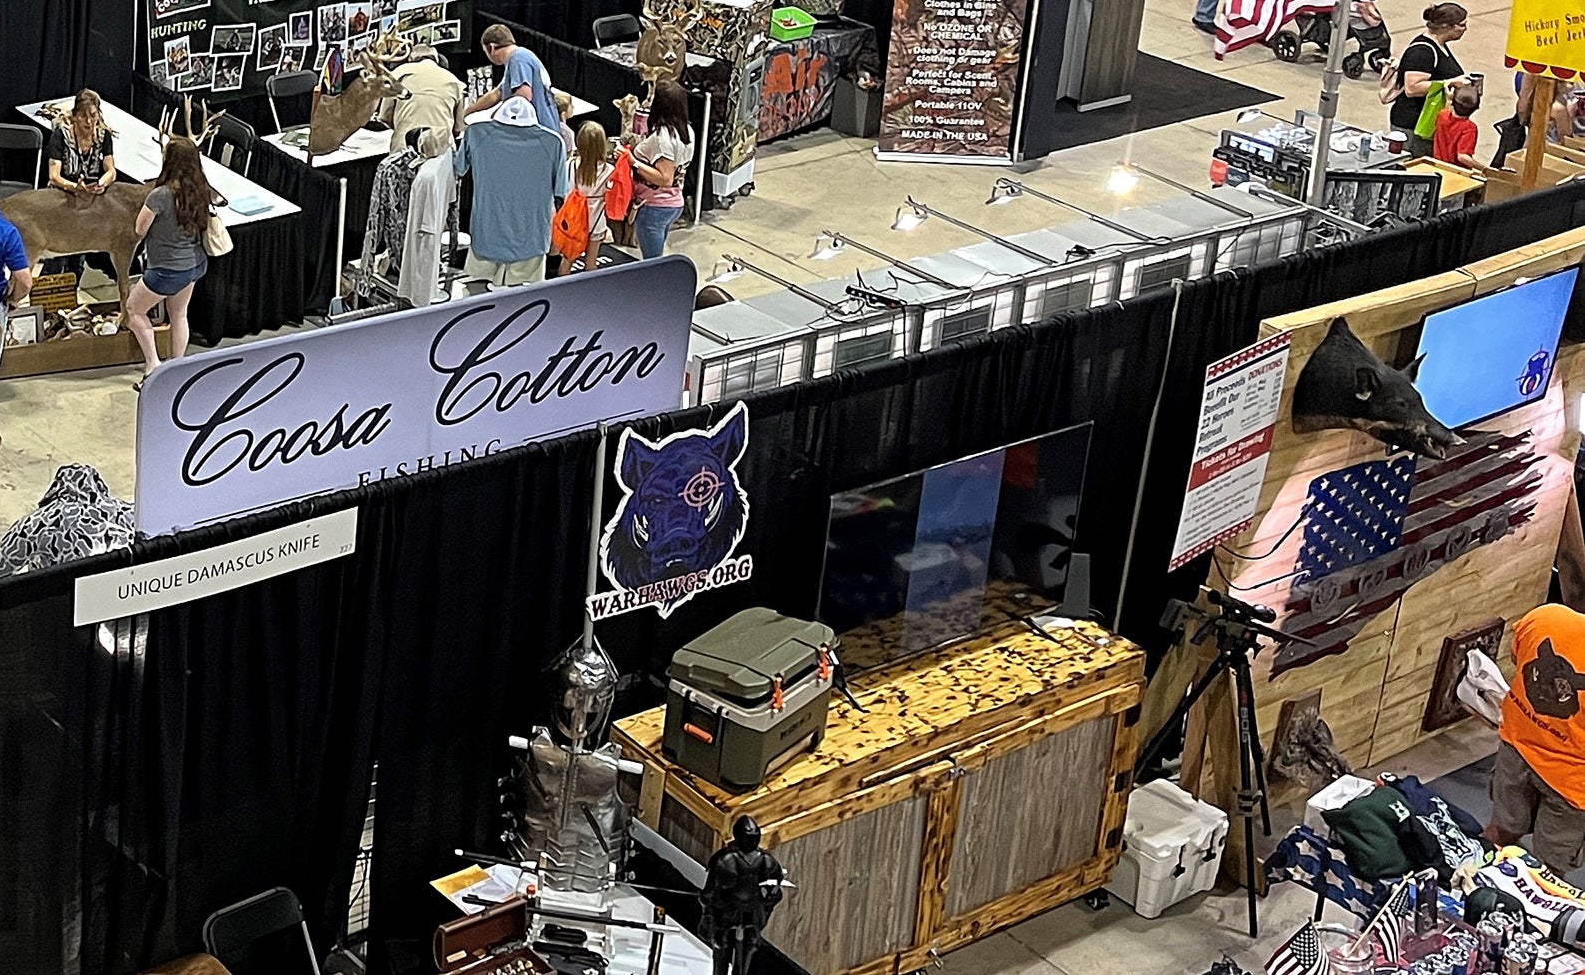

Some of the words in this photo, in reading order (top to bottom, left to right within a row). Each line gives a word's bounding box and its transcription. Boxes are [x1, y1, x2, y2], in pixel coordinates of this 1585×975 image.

[936, 9, 955, 17] and
[151, 19, 207, 39] HUNTING
[939, 24, 975, 33] OZONE
[977, 25, 993, 33] OR
[1525, 18, 1560, 33] Hickory
[930, 32, 983, 41] CHEMICAL
[1536, 32, 1559, 47] Beef
[979, 79, 997, 88] and
[929, 86, 972, 96] Campers
[915, 99, 954, 110] Portable
[909, 115, 933, 125] 100%
[901, 129, 932, 139] MADE
[945, 131, 965, 141] THE
[967, 132, 989, 141] USA
[170, 352, 393, 487] Coosa
[429, 298, 665, 427] Cotton
[118, 573, 183, 600] UNIQUE
[187, 548, 275, 585] DAMASCUS
[278, 533, 321, 559] KNIFE
[592, 558, 751, 619] WARHAWGS.ORG
[1240, 706, 1251, 744] BOG
